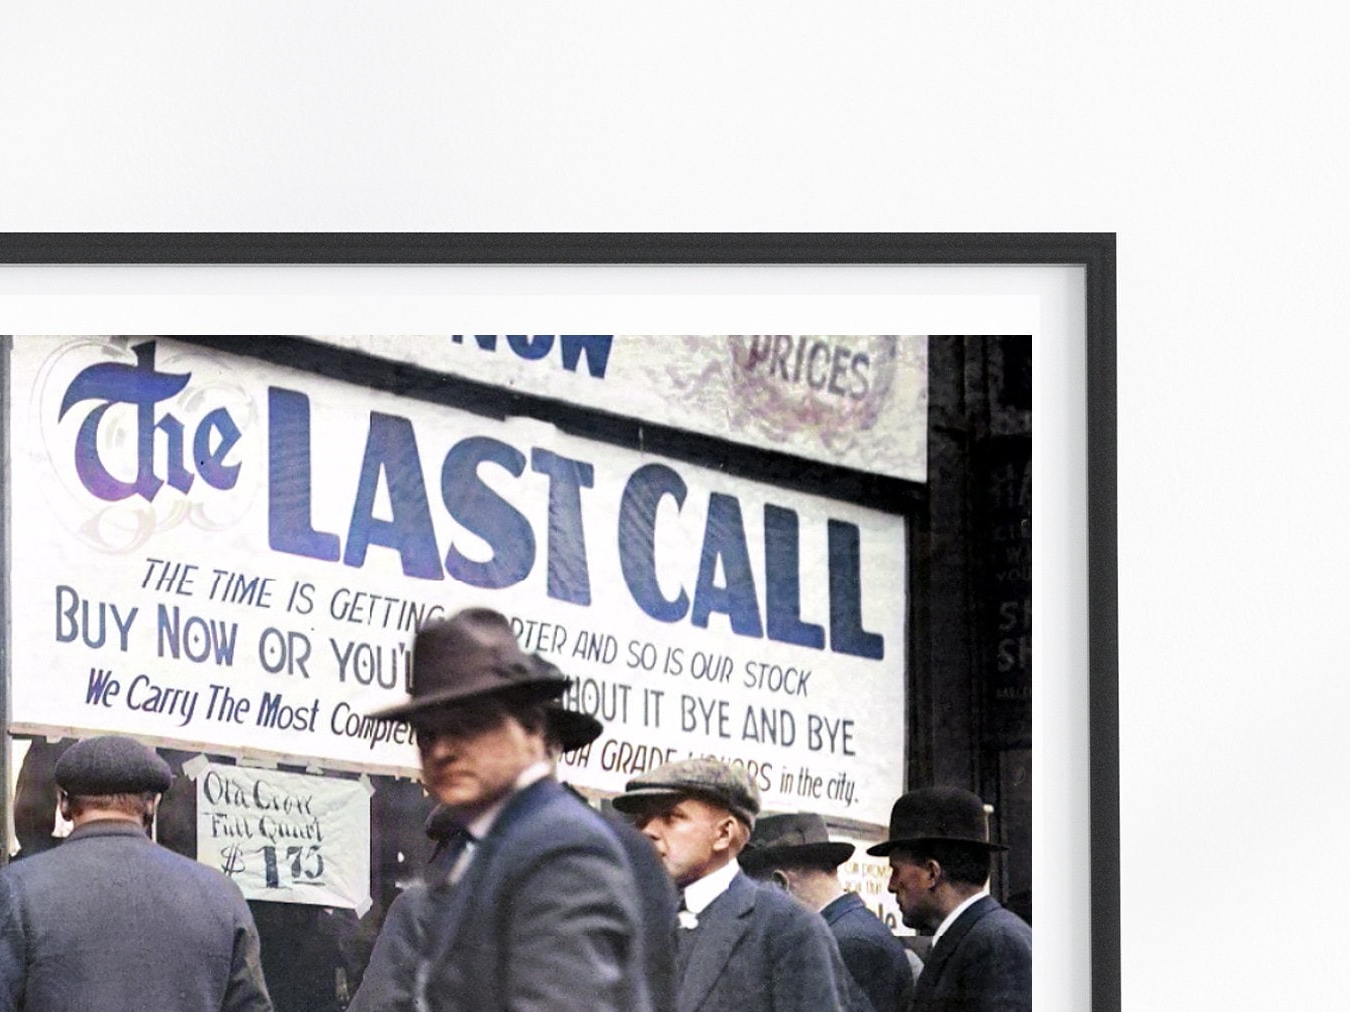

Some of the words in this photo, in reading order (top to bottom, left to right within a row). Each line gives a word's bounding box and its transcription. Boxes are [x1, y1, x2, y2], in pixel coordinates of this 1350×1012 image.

[744, 335, 871, 400] PRICES
[58, 341, 243, 502] The
[267, 385, 595, 607] LAST
[617, 463, 885, 661] CALL
[55, 584, 140, 653] BUY
[157, 603, 238, 667] NOW
[259, 626, 312, 680] OR
[329, 637, 415, 696] YOU'L
[561, 675, 632, 725] HOUT
[643, 688, 665, 728] IT
[681, 694, 732, 739] BYE
[742, 705, 796, 747] AND
[808, 715, 857, 756] BYE
[141, 558, 199, 597] THE
[207, 569, 277, 609] TIME
[287, 581, 316, 615] IS
[572, 630, 618, 665] AND
[626, 639, 657, 672] SO
[663, 646, 684, 676] IS
[690, 651, 734, 683] OUR
[743, 661, 812, 698] STOCK
[86, 668, 120, 706] We
[126, 674, 199, 728] Carry
[206, 684, 250, 725] The
[256, 692, 320, 734] Most
[331, 702, 417, 750] Complet
[779, 765, 796, 794] in
[797, 767, 823, 800] the
[828, 772, 861, 809] city.
[203, 771, 250, 809] Old
[203, 812, 253, 840] Full
[259, 815, 324, 845] Quart
